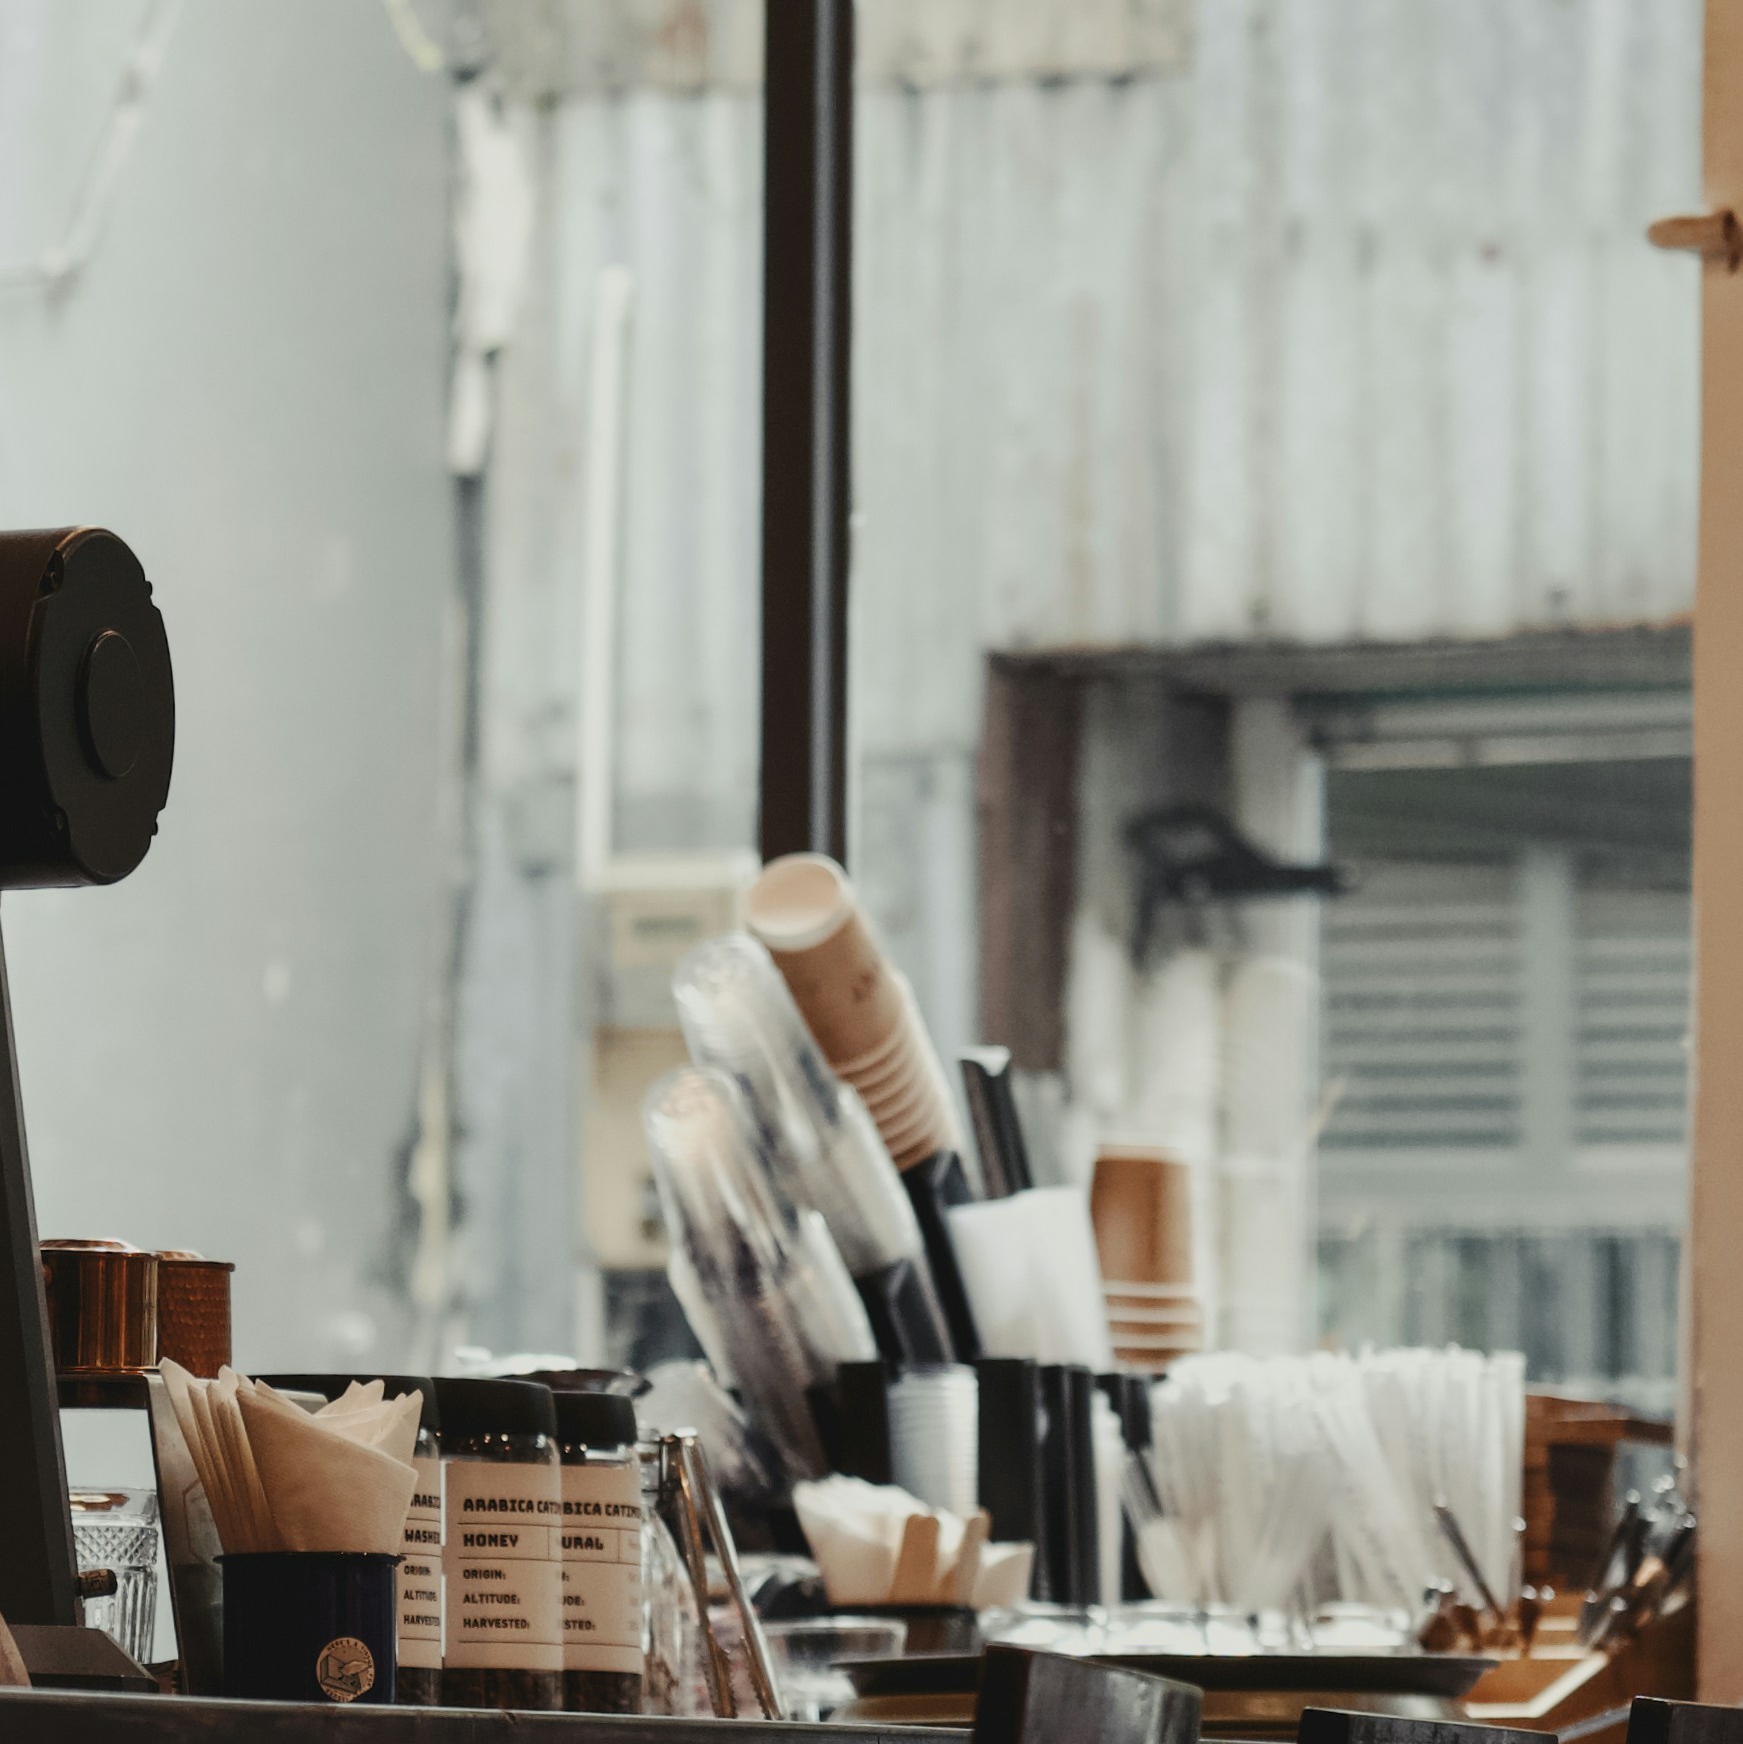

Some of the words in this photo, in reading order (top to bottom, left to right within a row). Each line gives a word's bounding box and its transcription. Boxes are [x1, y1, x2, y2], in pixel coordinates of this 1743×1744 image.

[463, 1498, 534, 1513] ARABICA
[463, 1533, 519, 1548] HONEY
[463, 1569, 506, 1580] ORIGIN:
[463, 1593, 521, 1605] ALTITUDE:
[463, 1618, 530, 1629] HARVESTED:
